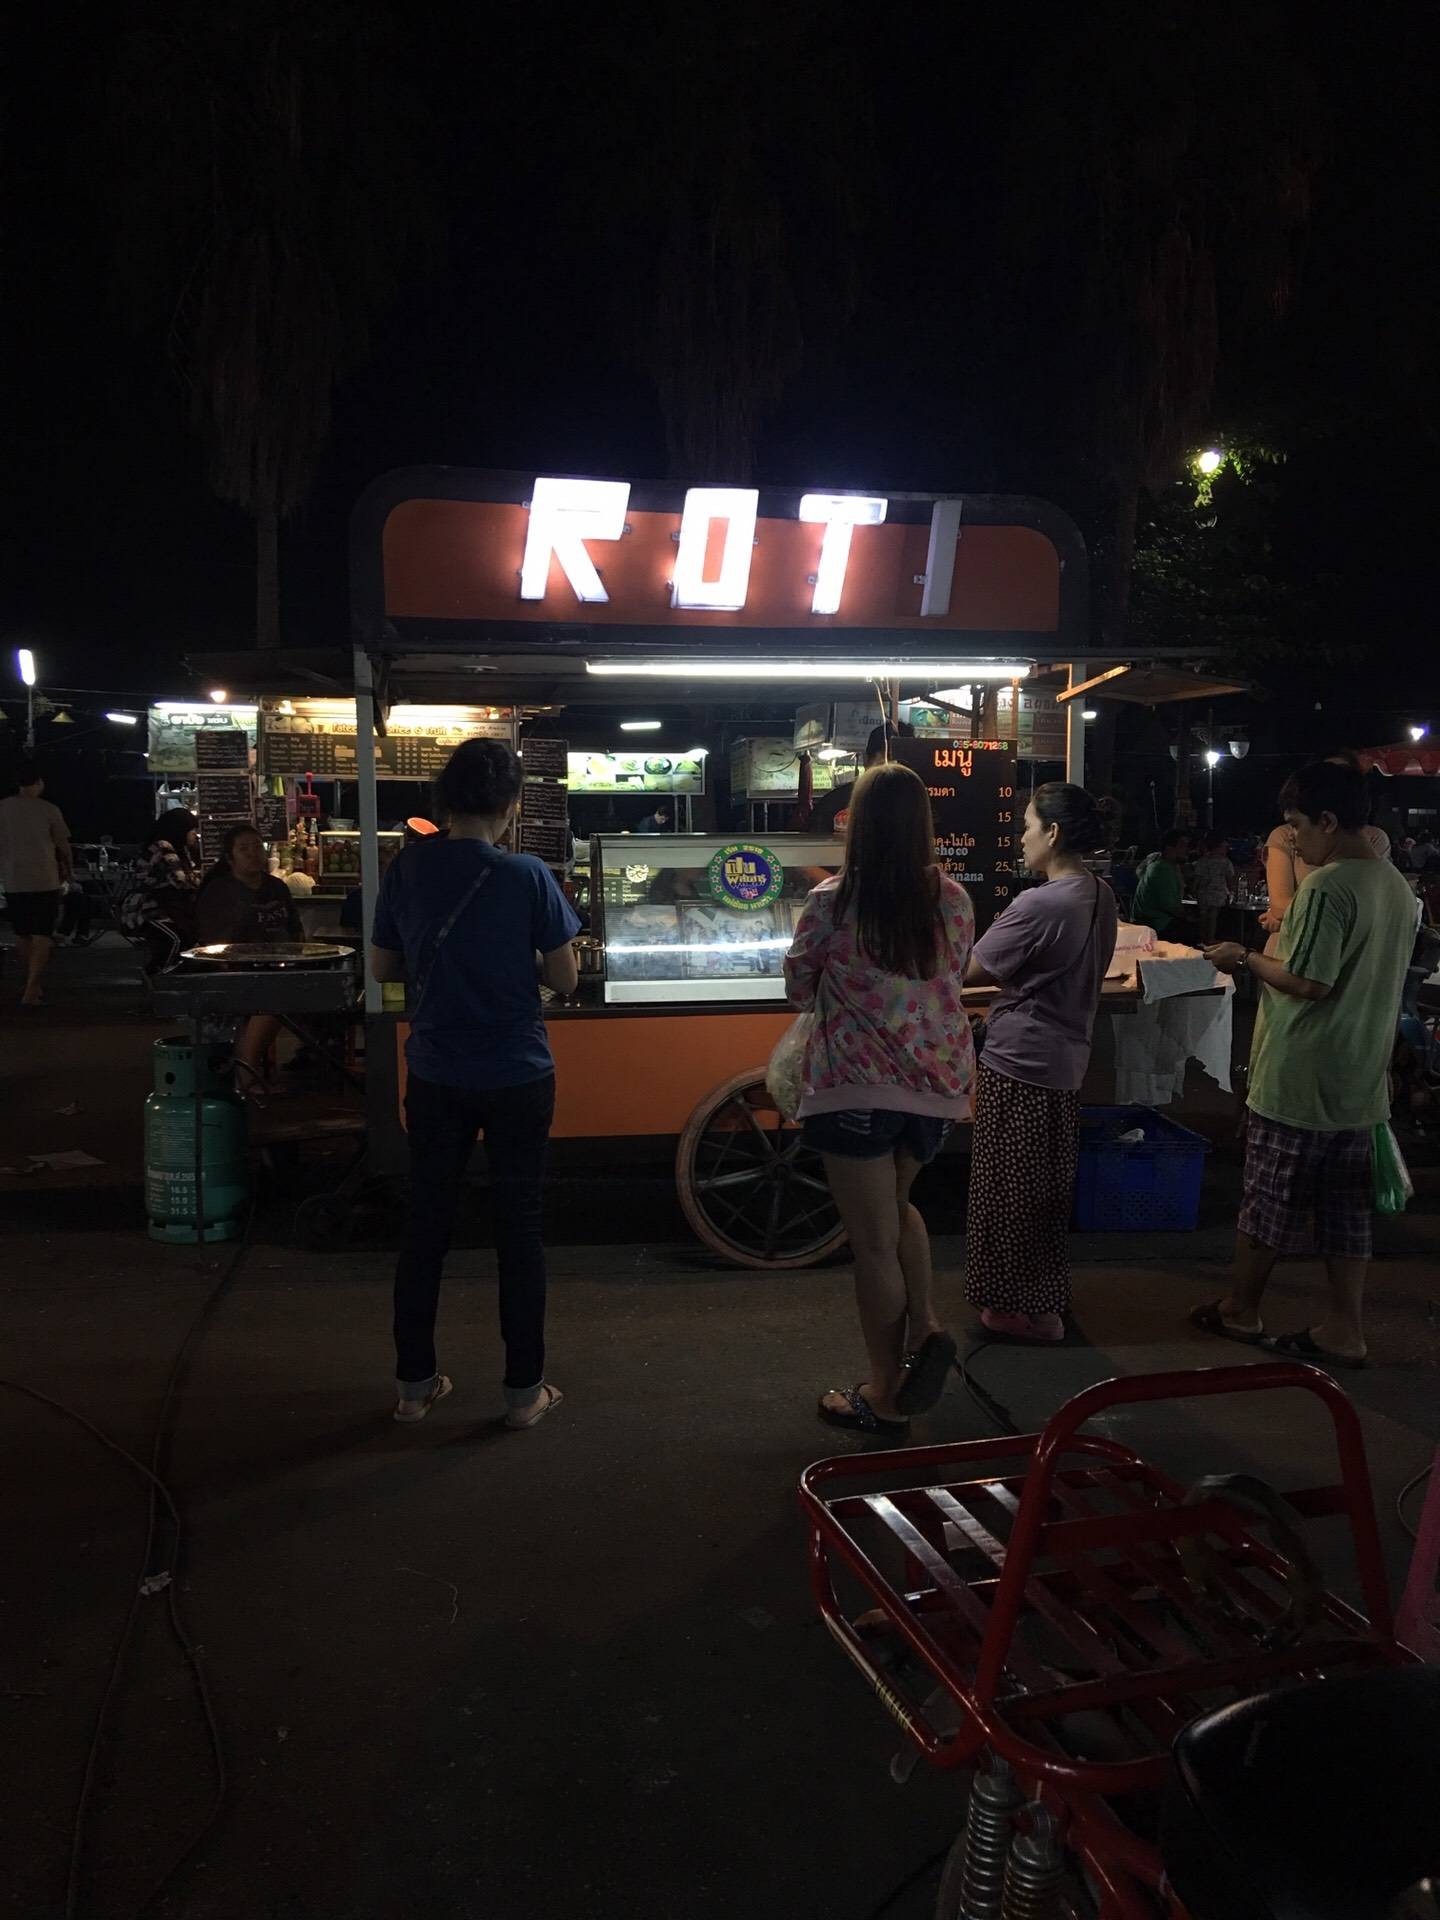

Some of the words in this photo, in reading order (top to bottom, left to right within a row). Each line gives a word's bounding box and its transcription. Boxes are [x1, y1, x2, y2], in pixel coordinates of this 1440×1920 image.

[520, 477, 963, 617] ROTI
[934, 749, 973, 777] เมนู
[924, 786, 956, 798] รมดา
[999, 786, 1013, 798] 10
[998, 811, 1012, 822] 15
[997, 836, 1011, 847] 15
[994, 861, 1010, 872] 25
[949, 872, 984, 882] anana
[993, 886, 1009, 897] 30
